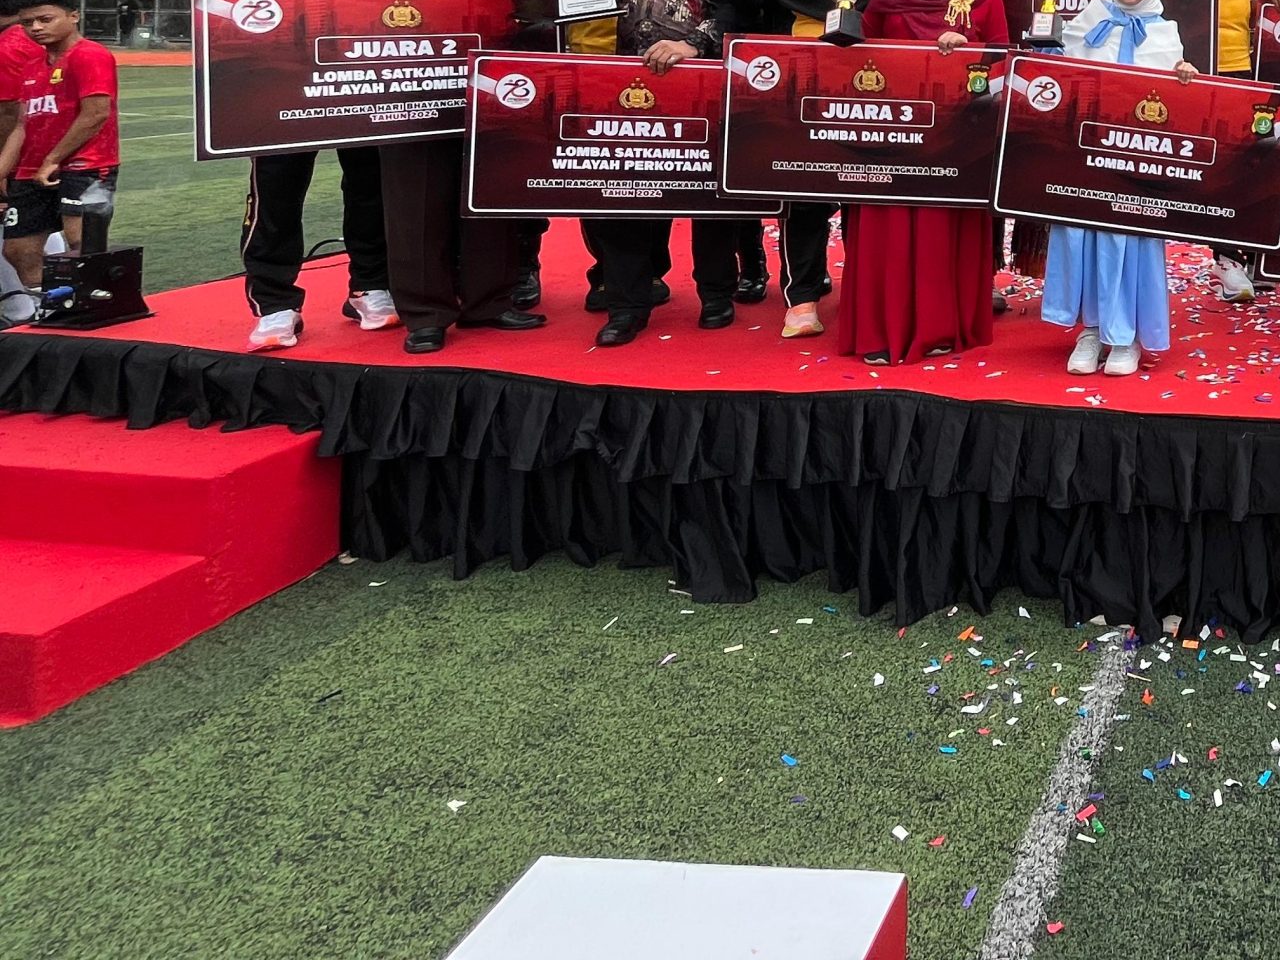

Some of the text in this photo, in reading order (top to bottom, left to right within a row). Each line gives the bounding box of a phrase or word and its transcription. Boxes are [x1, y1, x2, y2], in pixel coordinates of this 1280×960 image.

[344, 39, 457, 59] JUARA 2
[312, 69, 377, 84] LOMBA
[303, 78, 468, 98] WILAYAH AGLOMER
[279, 98, 467, 120] DALAM RANGKA HARI BHAYANGKA
[370, 109, 438, 123] TAHUN 2024
[821, 102, 913, 121] JUARA 3
[587, 120, 683, 138] JUARA 1
[809, 128, 924, 144] LOMBA DAI CILIK
[1100, 129, 1194, 157] JUARA 2
[556, 145, 710, 160] LOMBA SATKAMLING
[552, 158, 712, 172] WILAYAH PERKOTAAN
[772, 161, 958, 176] DALAM RANGKA HARI BHAYANGKARA KE-78
[1086, 154, 1203, 181] LOMBA DAI CILIK
[527, 178, 718, 190] DALAM RANGKA HARI BHAYANGKARA KE
[838, 172, 893, 183] TAHUN 2024
[602, 189, 663, 198] TAHUN 2024
[1046, 183, 1235, 218] DALAM RANGKA HARI BHAYANGKARA KE-78
[1112, 202, 1167, 218] TAHUN 2024
